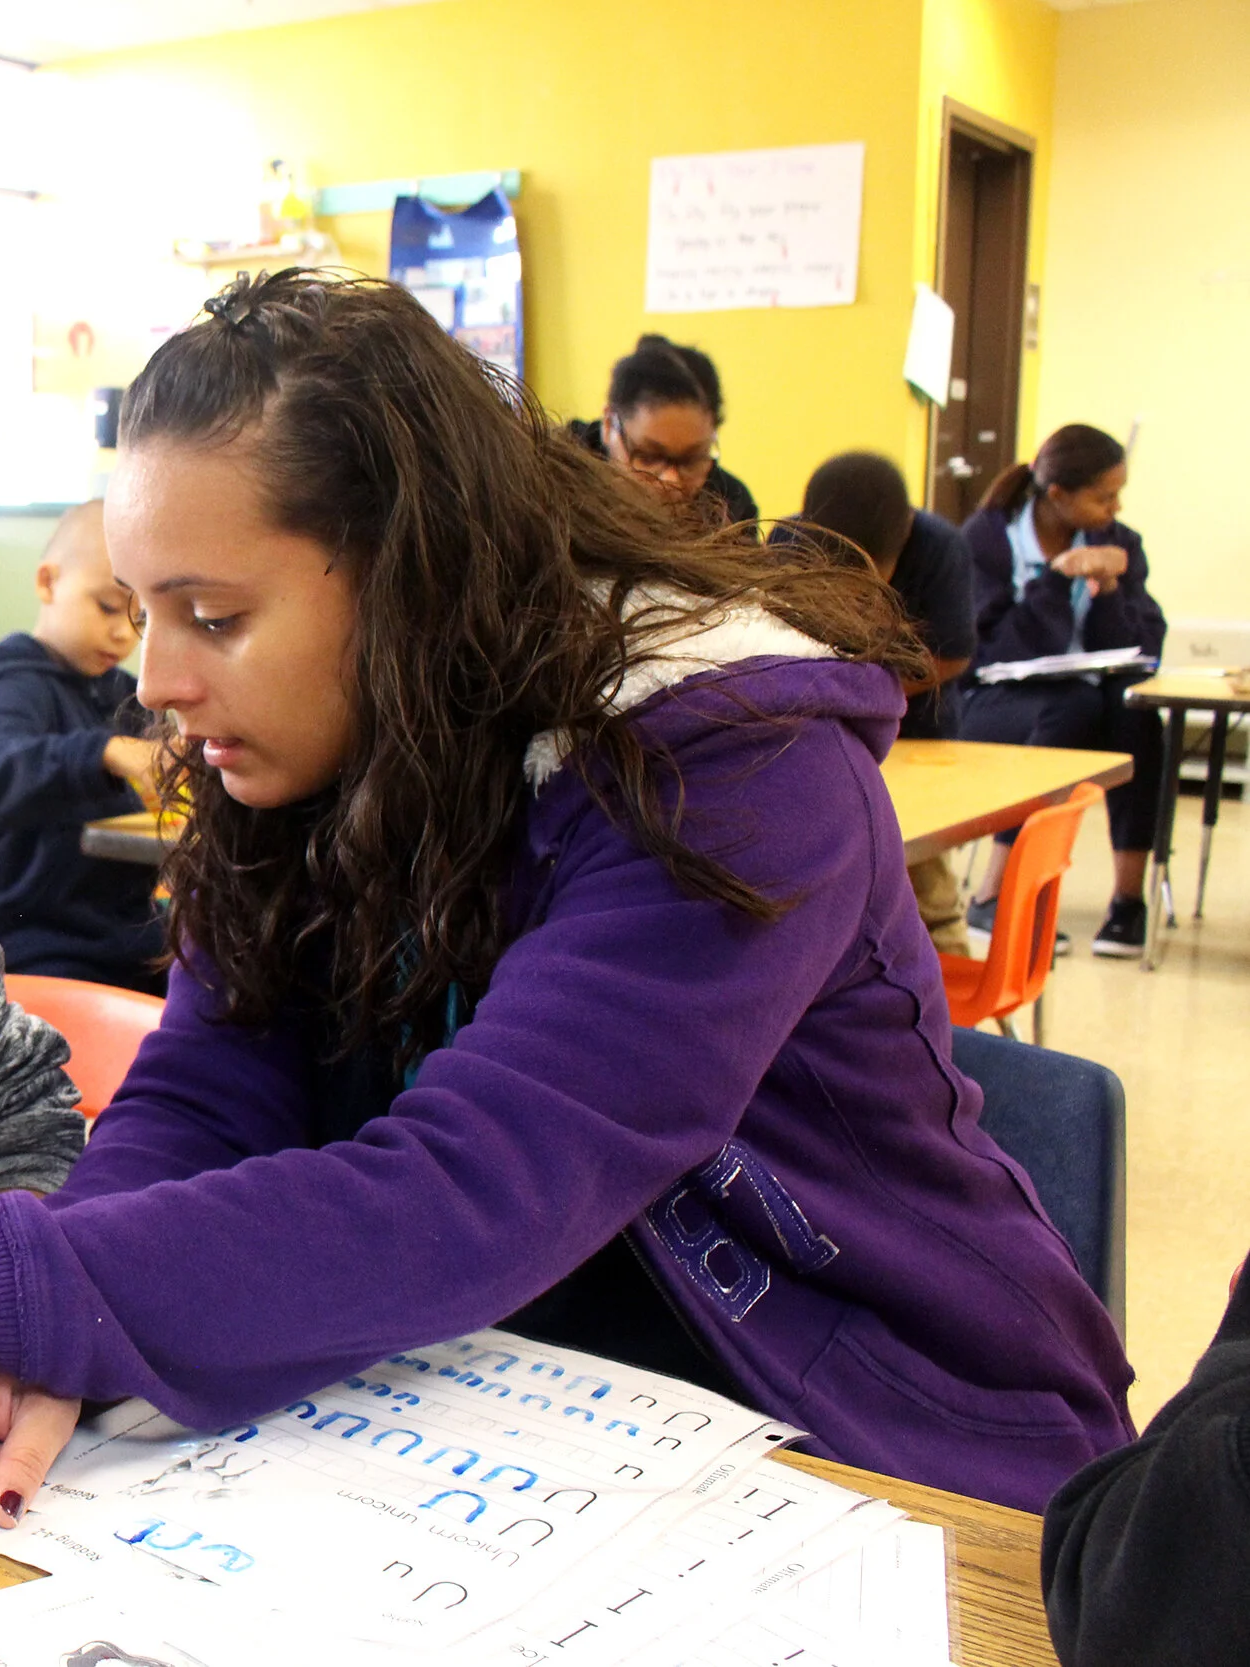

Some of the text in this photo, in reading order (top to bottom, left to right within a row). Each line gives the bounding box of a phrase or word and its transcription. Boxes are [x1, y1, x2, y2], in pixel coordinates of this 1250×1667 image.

[693, 1462, 737, 1496] Offimate
[336, 1486, 520, 1568] Unicorn unicorn
[53, 1533, 104, 1563] Reading
